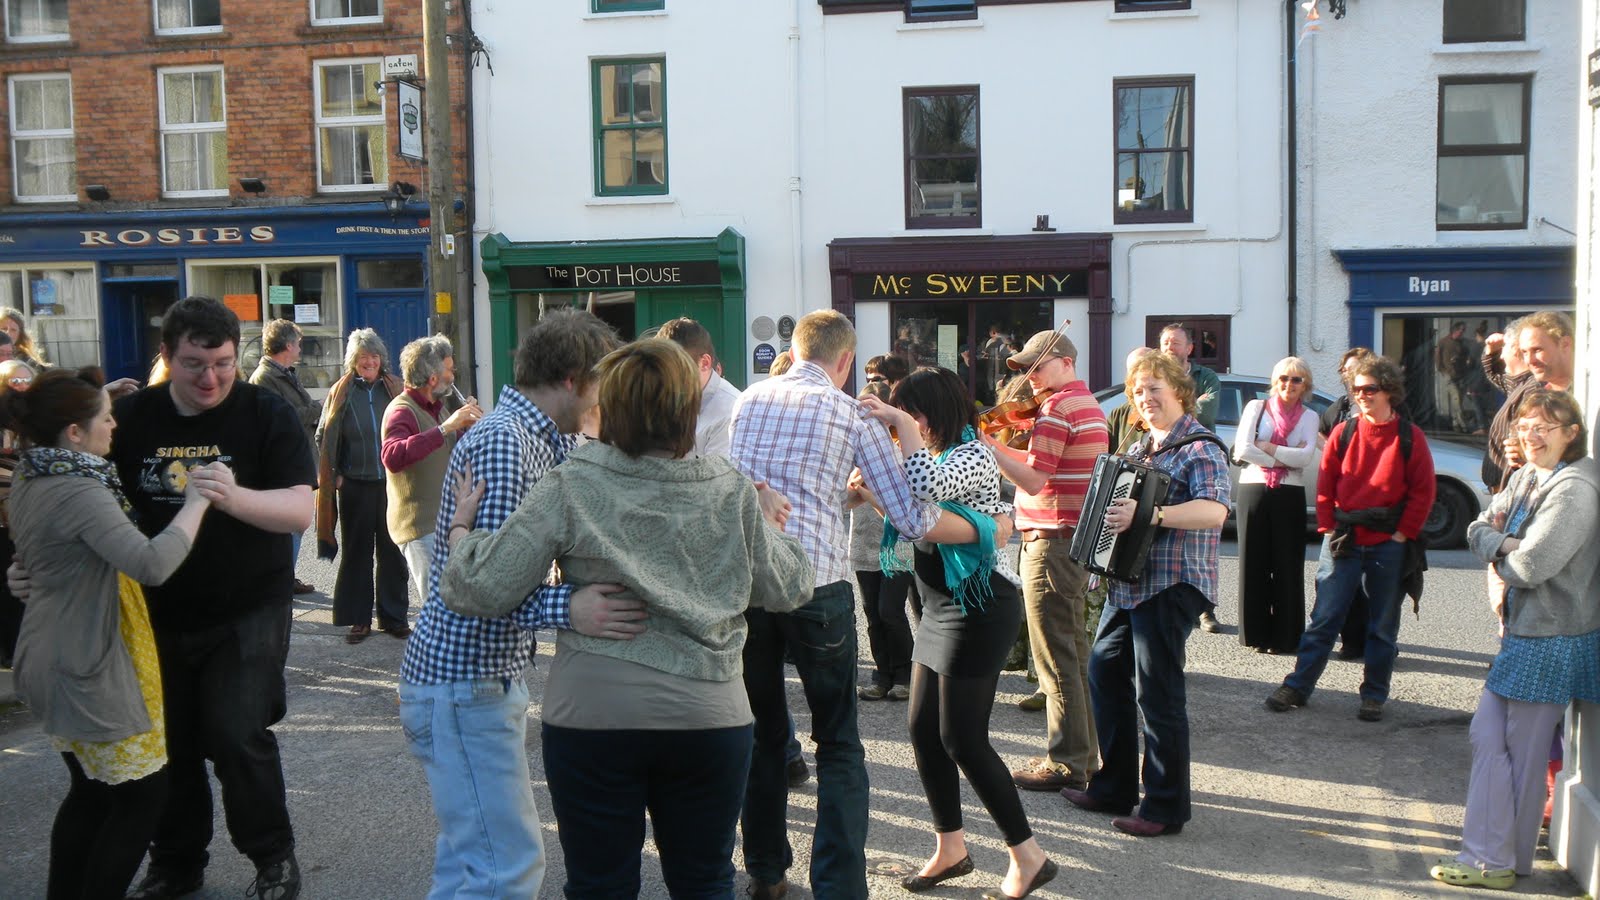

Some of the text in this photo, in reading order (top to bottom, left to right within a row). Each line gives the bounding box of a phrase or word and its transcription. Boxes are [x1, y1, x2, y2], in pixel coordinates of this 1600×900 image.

[79, 226, 275, 247] ROSIES
[336, 226, 355, 234] DRINK
[380, 227, 397, 235] THEN
[411, 227, 430, 235] STORY
[546, 266, 568, 278] The
[574, 264, 681, 287] POT HOUSE
[926, 273, 1071, 295] SWEENY
[1409, 276, 1450, 296] Ryan
[155, 445, 221, 457] SINGHA
